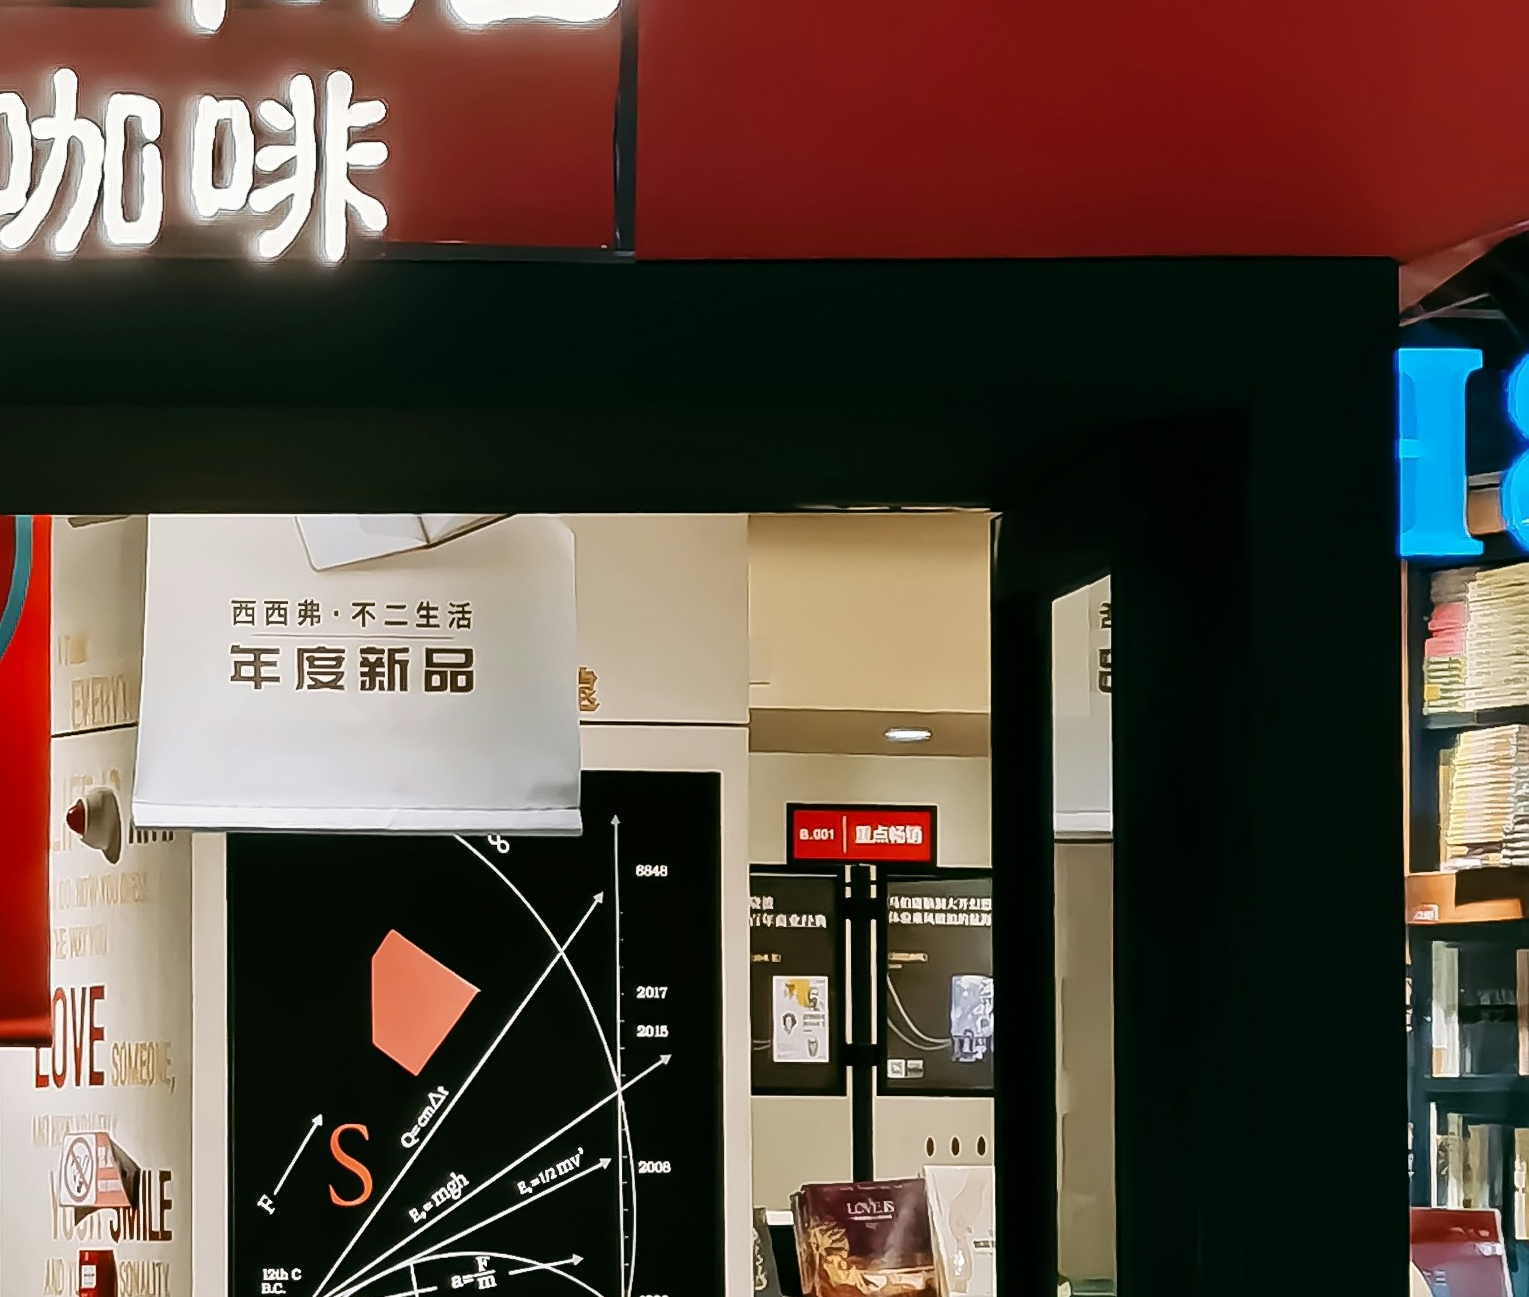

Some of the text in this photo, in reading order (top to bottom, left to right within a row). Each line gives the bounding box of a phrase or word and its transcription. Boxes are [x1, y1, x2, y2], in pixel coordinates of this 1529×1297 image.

[229, 644, 475, 693] 年度新品
[799, 829, 835, 841] B.001
[635, 985, 669, 1000] 2017
[328, 1122, 374, 1208] S
[638, 1161, 671, 1174] 2008
[256, 1193, 277, 1215] F
[291, 1268, 302, 1281] C
[261, 1283, 287, 1295] B.C.
